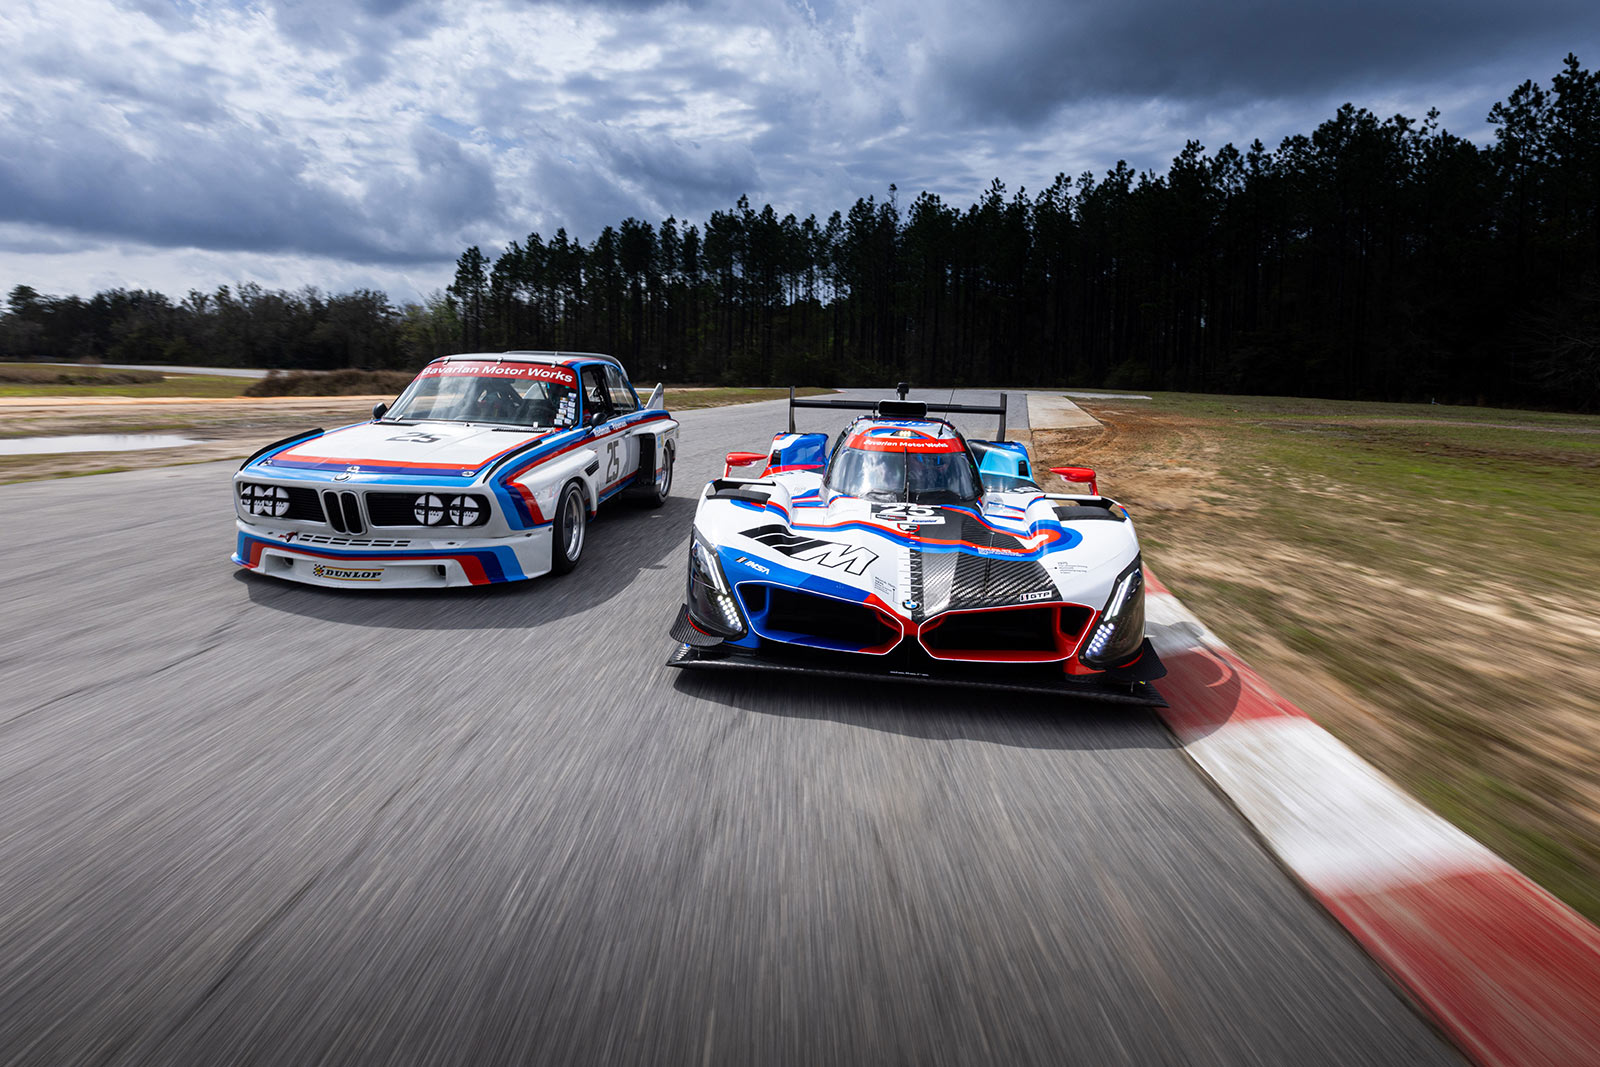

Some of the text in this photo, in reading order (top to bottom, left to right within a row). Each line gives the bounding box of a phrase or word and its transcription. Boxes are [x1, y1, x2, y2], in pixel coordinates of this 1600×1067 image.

[421, 365, 573, 383] Bavarian Motor Works
[606, 440, 620, 484] 25
[880, 502, 941, 517] 25
[326, 569, 382, 579] DUNLOP
[744, 560, 770, 575] IMSA
[1030, 591, 1051, 599] GTP
